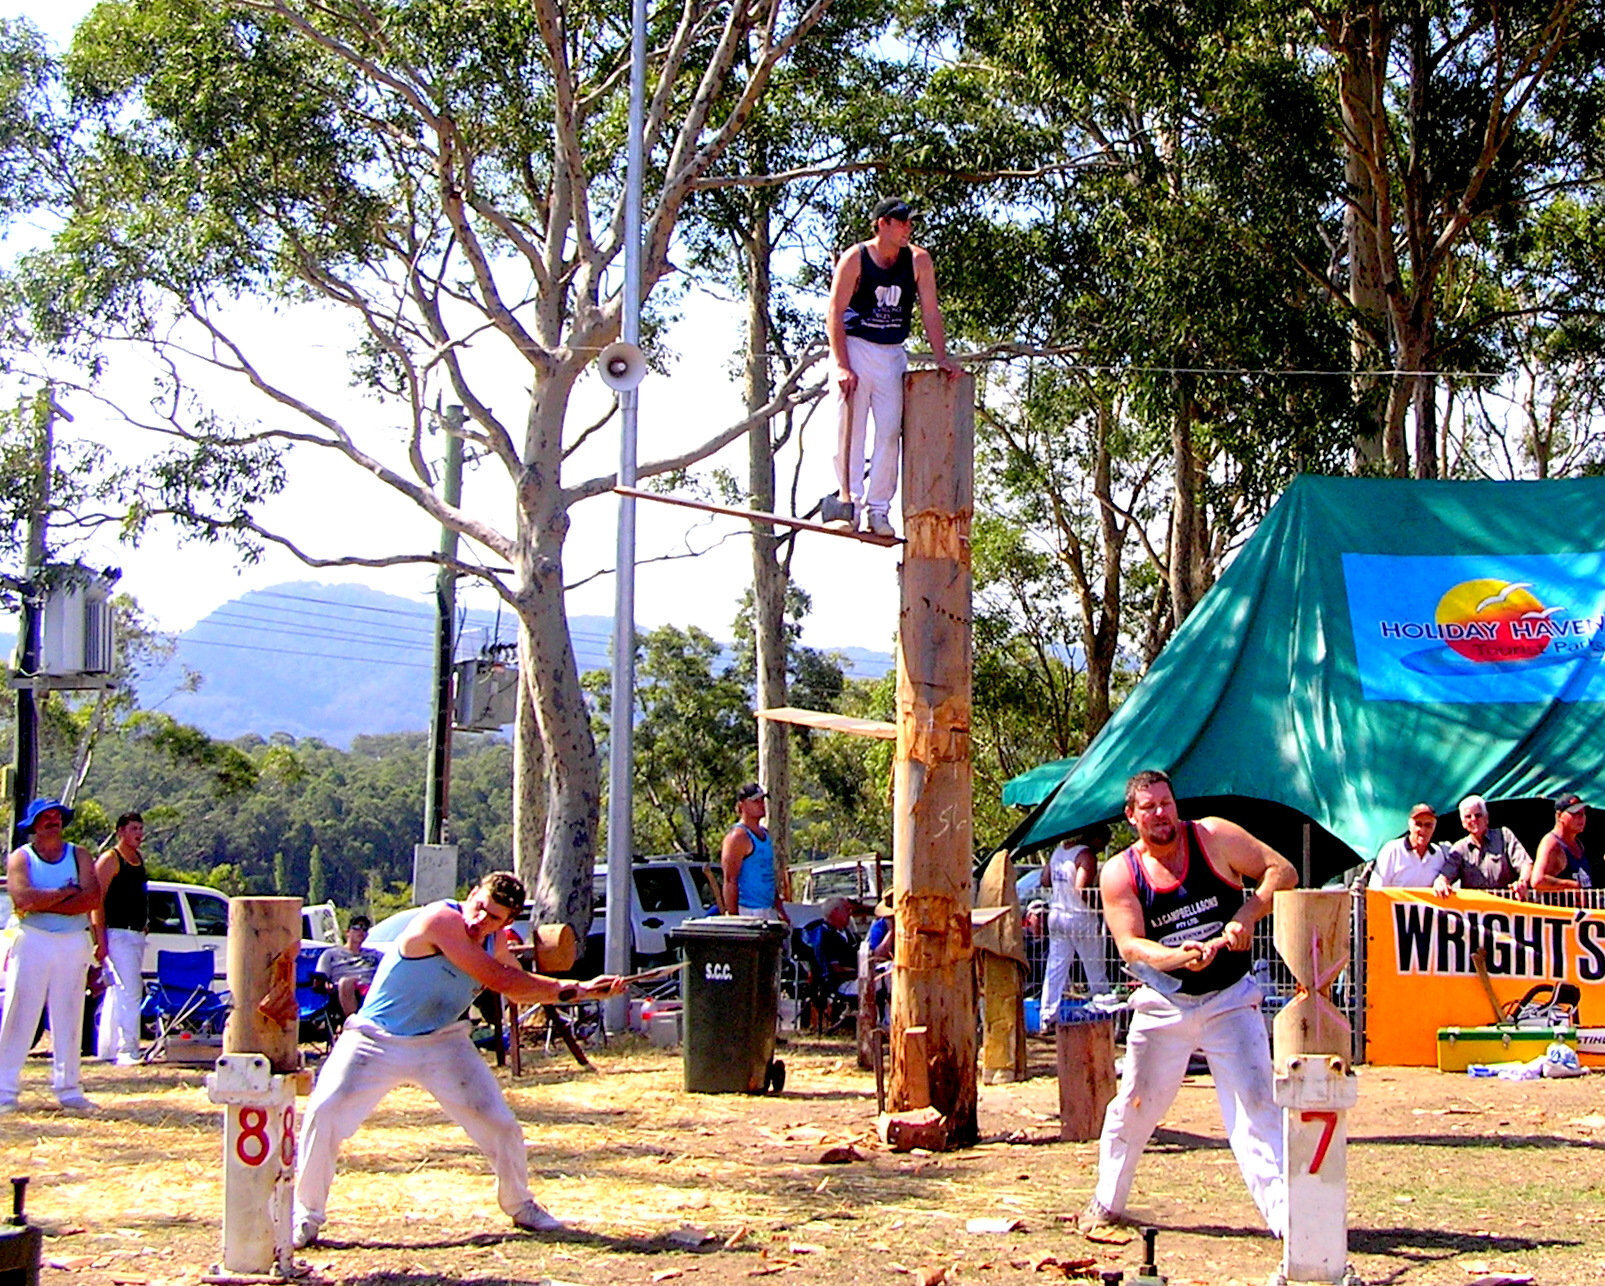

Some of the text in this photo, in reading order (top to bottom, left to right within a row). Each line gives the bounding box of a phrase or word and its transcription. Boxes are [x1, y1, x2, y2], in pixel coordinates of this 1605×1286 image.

[1380, 620, 1498, 640] HOLIDAY
[1471, 643, 1545, 658] Tourist
[1393, 903, 1605, 981] WRIGHT'S
[237, 1104, 270, 1167] 8
[281, 1105, 295, 1167] 8
[1300, 1111, 1338, 1175] 7
